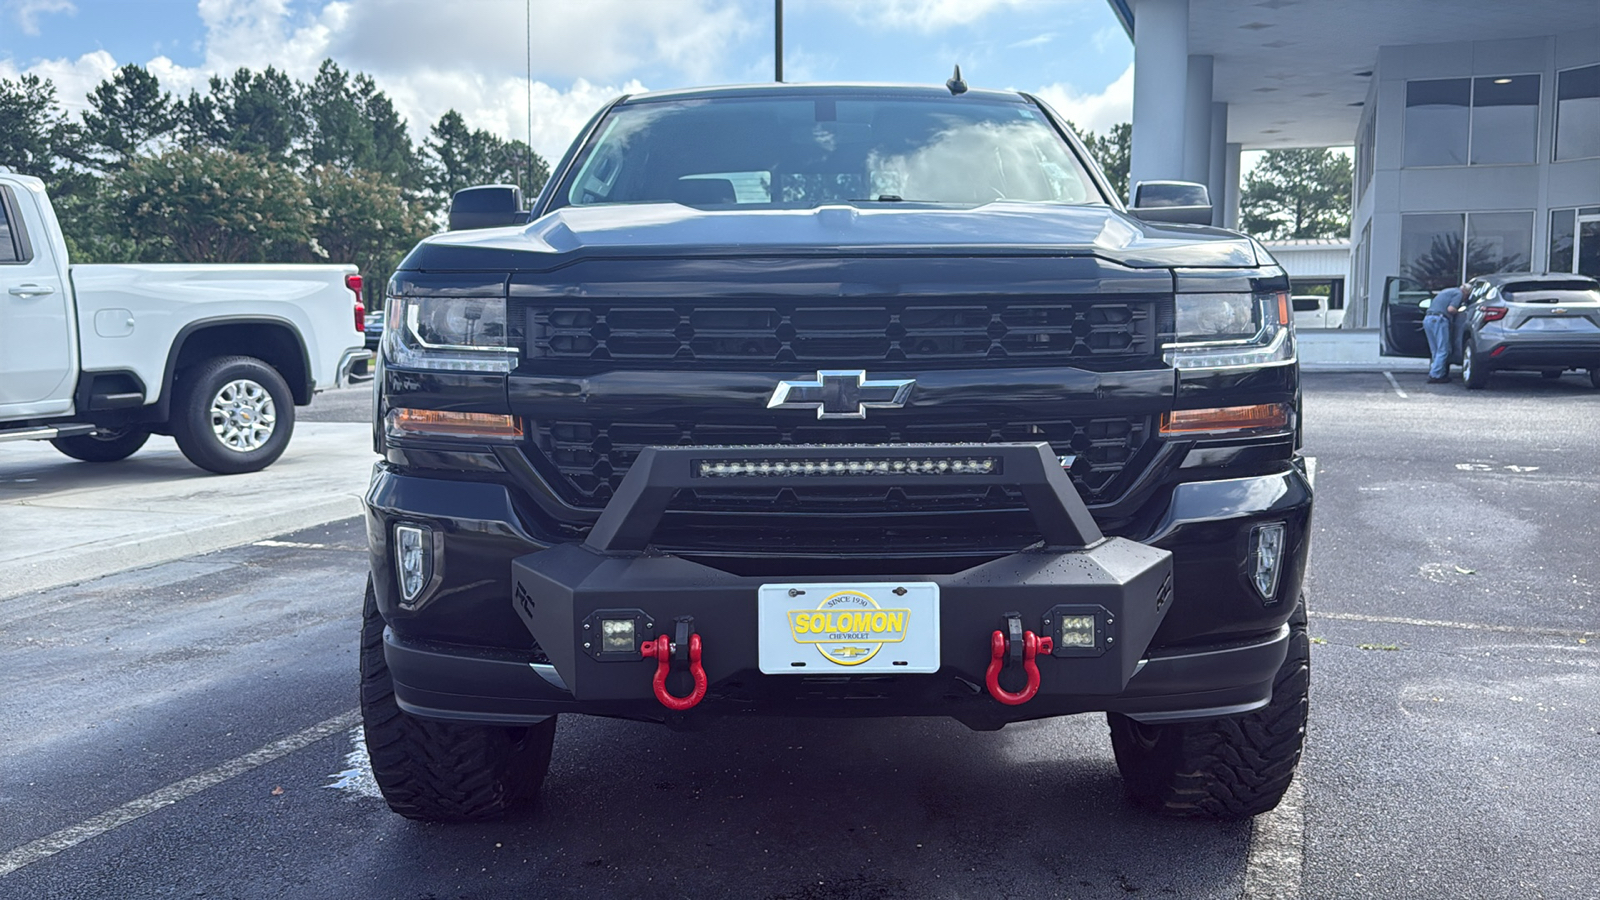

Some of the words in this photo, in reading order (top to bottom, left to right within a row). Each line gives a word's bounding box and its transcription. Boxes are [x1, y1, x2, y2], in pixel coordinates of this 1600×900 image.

[827, 596, 851, 608] SINCE
[852, 596, 868, 607] 1930
[795, 612, 903, 634] SOLOMON
[829, 632, 870, 640] CHEVROLET
